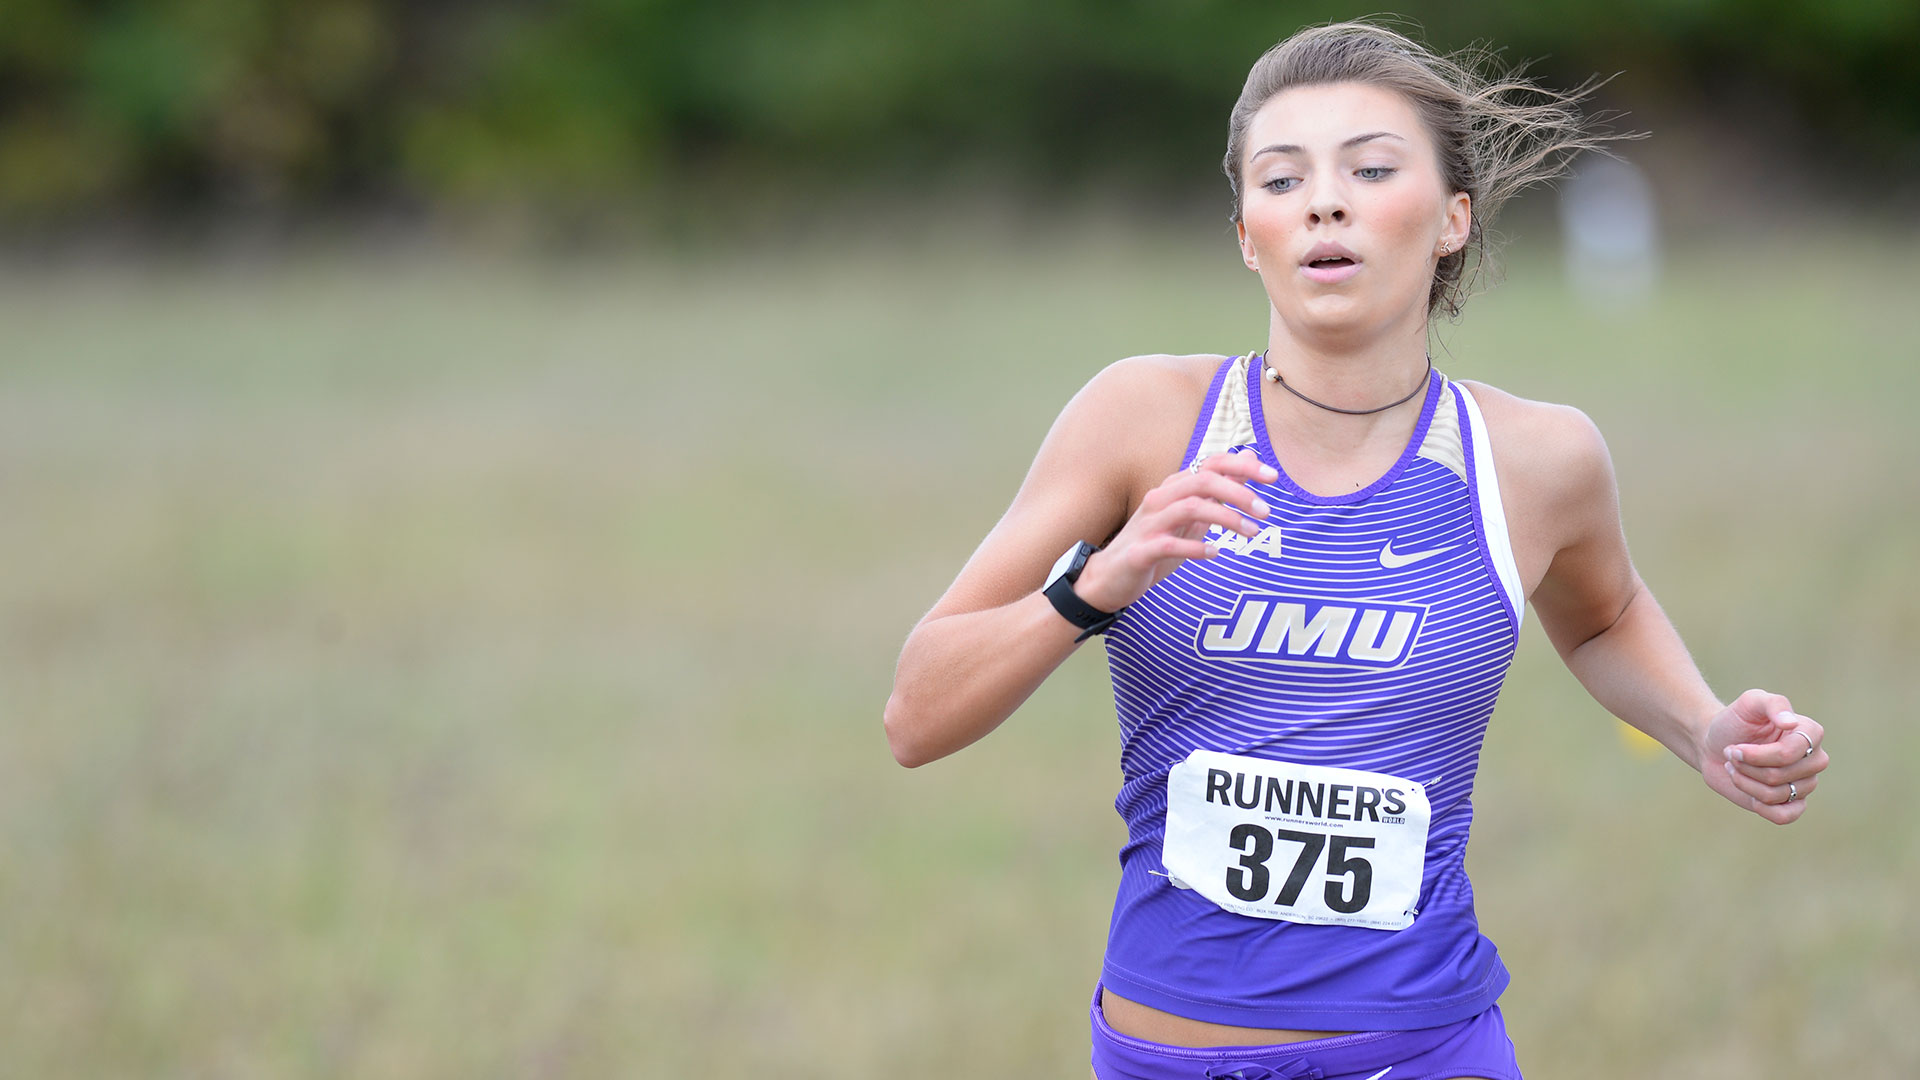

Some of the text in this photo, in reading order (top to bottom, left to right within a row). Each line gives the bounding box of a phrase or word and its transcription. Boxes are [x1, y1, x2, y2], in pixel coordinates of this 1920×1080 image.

[1205, 523, 1282, 559] AA
[1202, 600, 1418, 662] JMU
[1206, 767, 1406, 823] RUNNER'S
[1264, 815, 1344, 829] www.runnersworld.com
[1225, 823, 1376, 914] 375
